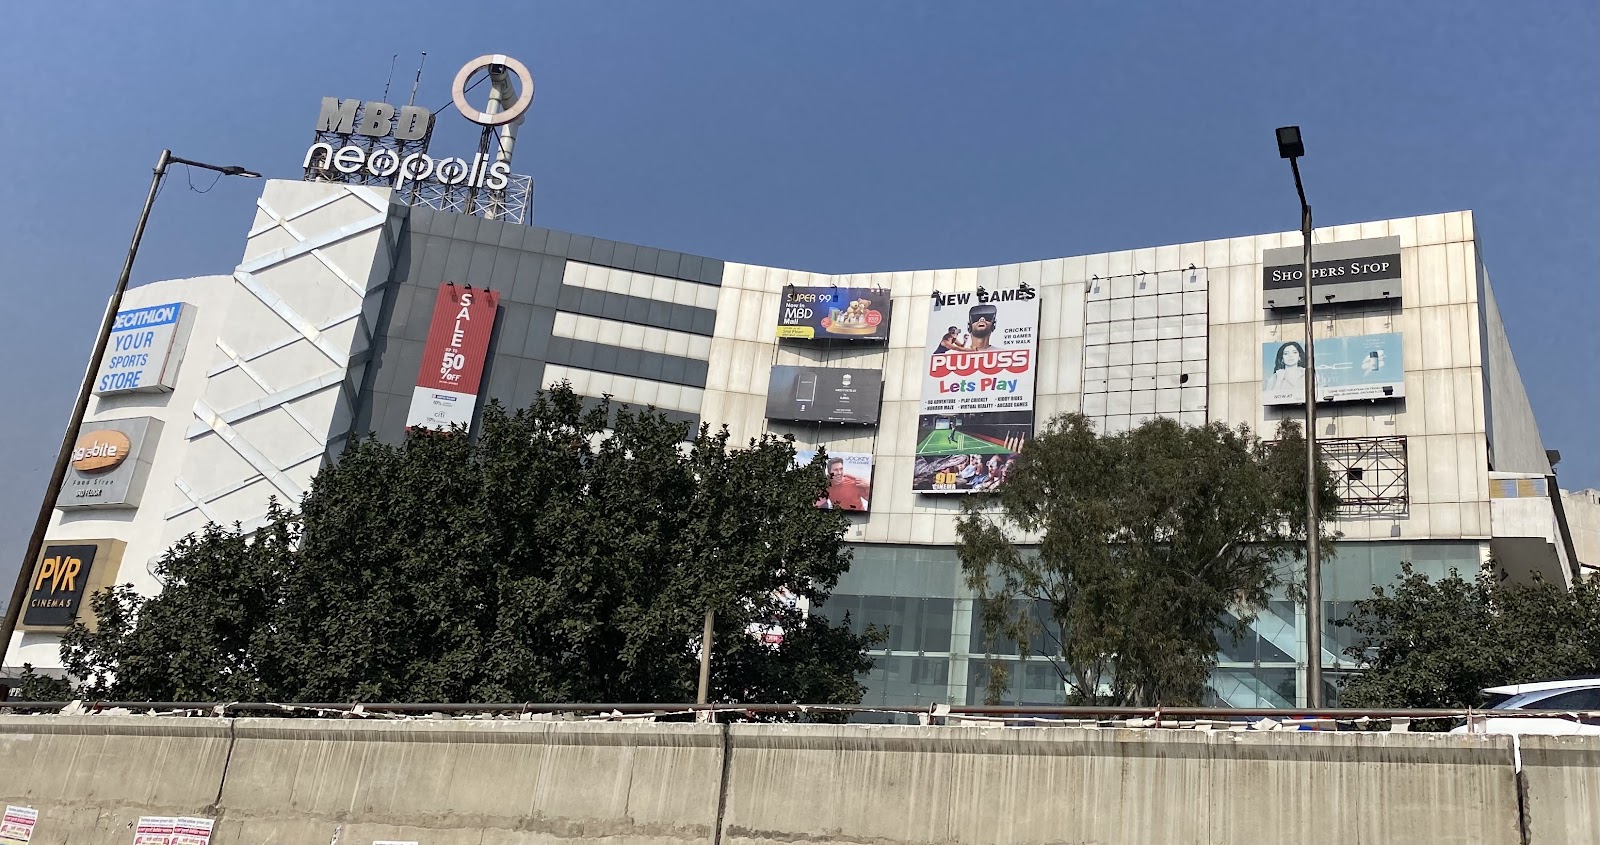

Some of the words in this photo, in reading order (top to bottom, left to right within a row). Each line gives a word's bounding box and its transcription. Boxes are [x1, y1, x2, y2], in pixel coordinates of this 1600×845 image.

[315, 97, 430, 140] MBD
[303, 143, 510, 190] neopolis
[1272, 265, 1345, 282] SHOPERS
[1351, 262, 1390, 275] STOP
[786, 292, 816, 303] SUPER
[818, 294, 832, 303] 99
[934, 292, 972, 307] NEW
[977, 287, 1036, 303] GAMES
[451, 293, 472, 347] SALE
[784, 307, 814, 319] MBD
[1004, 326, 1032, 334] CRICKET
[115, 331, 154, 352] YOUR
[109, 353, 149, 370] SPORTS
[931, 350, 1028, 372] PLUTUSS
[100, 370, 143, 391] STORE
[939, 379, 976, 394] Lets
[980, 377, 1017, 394] Play
[935, 472, 956, 484] 9D
[35, 555, 82, 596] PVR
[31, 598, 72, 608] CINEMAS
